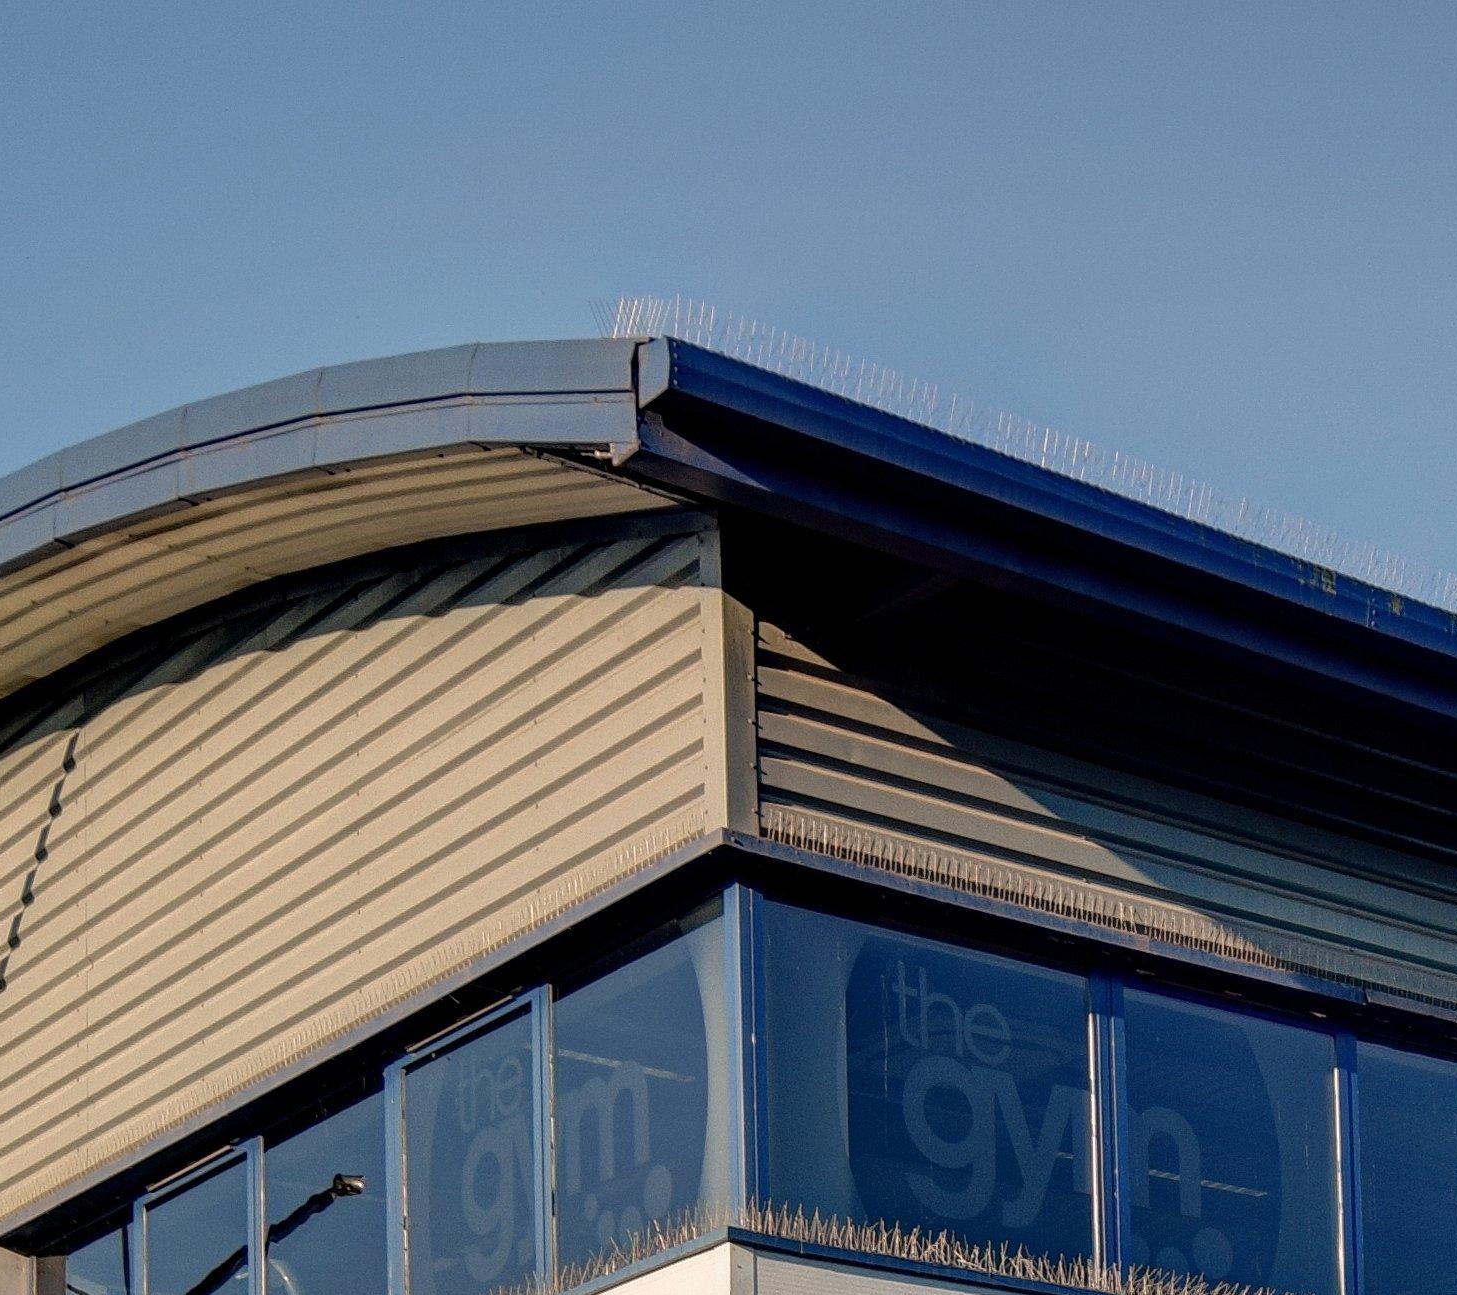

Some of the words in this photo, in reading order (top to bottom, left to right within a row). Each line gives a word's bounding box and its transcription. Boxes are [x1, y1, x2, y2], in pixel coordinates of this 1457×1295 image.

[892, 960, 1012, 1064] the
[454, 1055, 524, 1133] the
[903, 1054, 1202, 1229] gym
